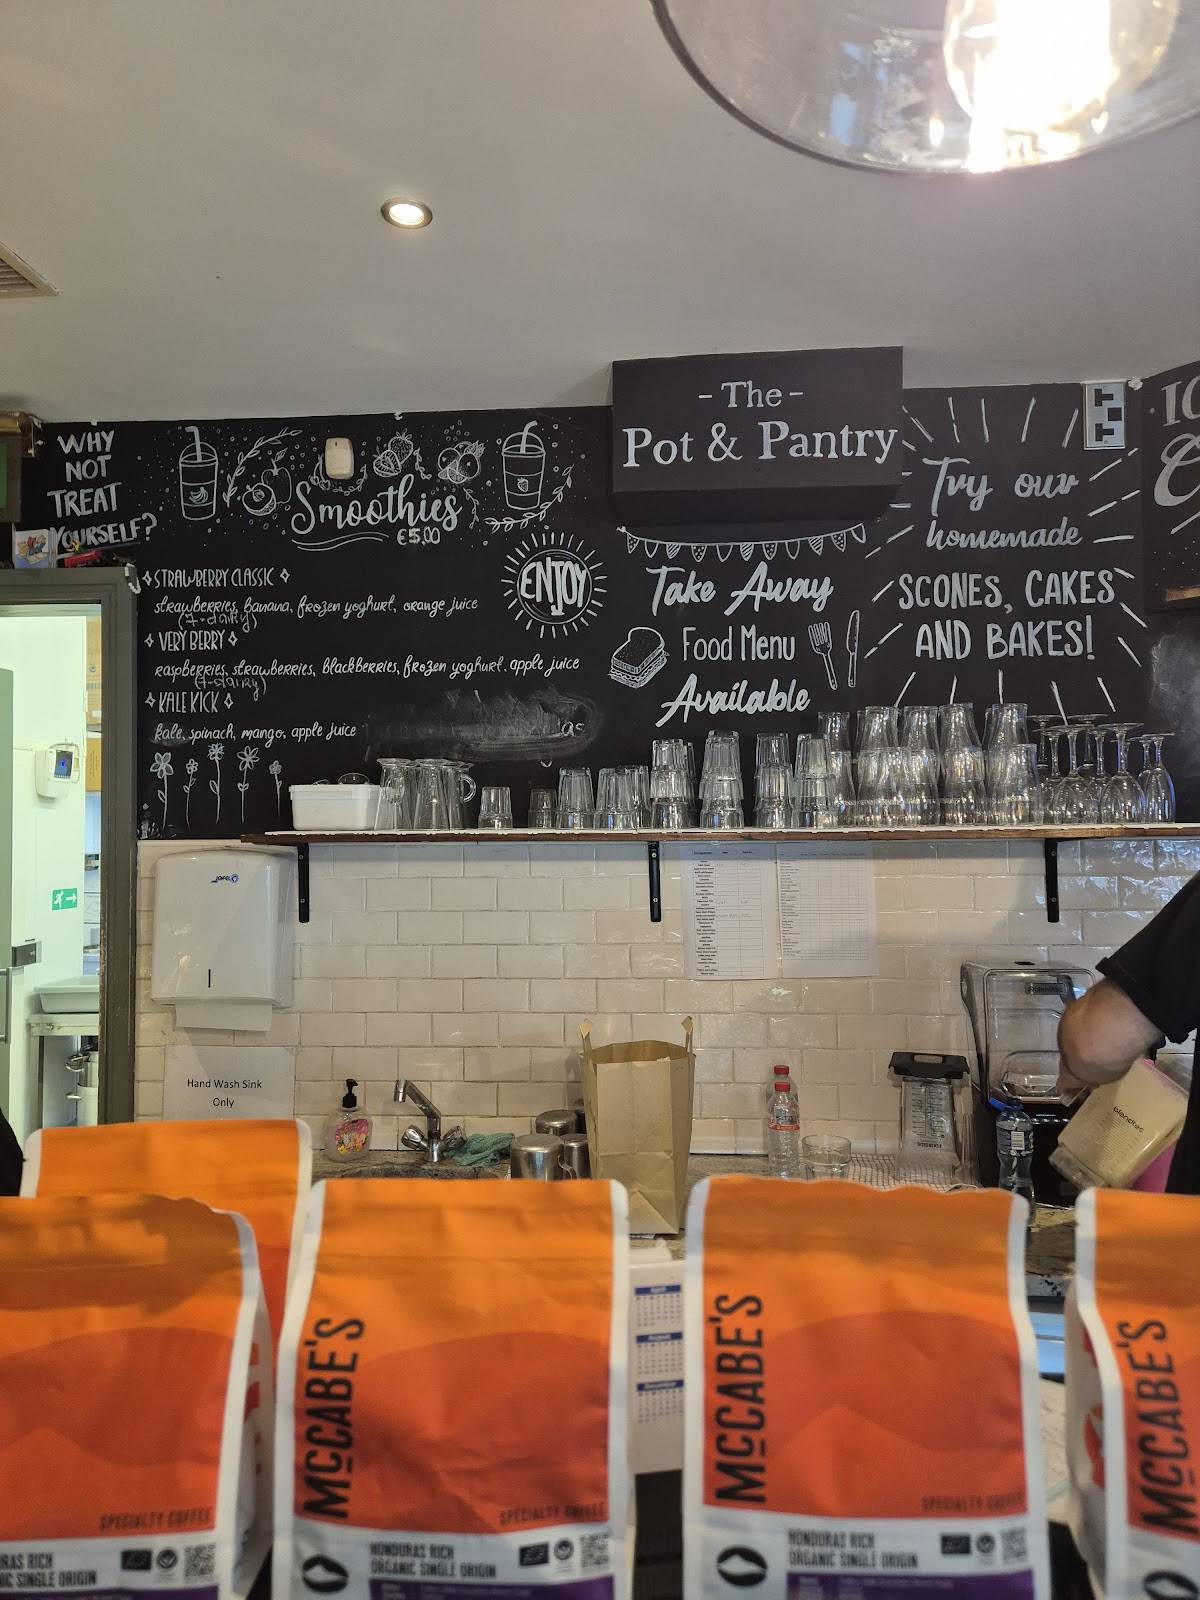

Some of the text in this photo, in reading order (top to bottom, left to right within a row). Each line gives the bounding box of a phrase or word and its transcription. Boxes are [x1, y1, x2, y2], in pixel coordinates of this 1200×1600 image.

[721, 380, 783, 408] The
[57, 430, 115, 456] WHY
[622, 420, 898, 468] Pot & Pantry
[66, 454, 112, 483] NOT
[922, 456, 1080, 517] Try our
[47, 481, 122, 519] TREAT
[291, 473, 463, 535] Smoothies
[49, 512, 158, 548] YOURSELF?
[396, 526, 441, 546] €5.00
[926, 516, 1083, 550] homemade
[154, 566, 275, 589] STRAWBERRY CLASSIC
[520, 556, 587, 616] ENJOY
[645, 560, 834, 617] Take Away
[898, 569, 1116, 616] SCONES, CAKES
[154, 595, 239, 614] strawberries,
[297, 594, 341, 619] frozen
[342, 594, 397, 619] yoghurt,
[403, 598, 446, 618] orange
[446, 596, 479, 617] juice
[158, 629, 226, 652] VERY BERRY
[682, 623, 796, 662] Food Menu
[915, 614, 1096, 662] AND BAKES!
[154, 658, 229, 684] raspberries,
[231, 658, 317, 678] strawberries,
[403, 655, 447, 679] frozen
[509, 653, 545, 677] apple
[544, 656, 580, 678] juice
[158, 690, 220, 713] KALE KICK
[655, 672, 811, 728] Available
[291, 721, 324, 743] apple
[325, 722, 357, 741] juice
[187, 1078, 263, 1090] Hand Wash Sink
[212, 1097, 235, 1110] Only
[100, 1507, 213, 1531] SPECIALTY COFFEE
[500, 1505, 560, 1526] SPECIALTY
[369, 1541, 455, 1561] HONDURAS RICH
[788, 1528, 876, 1550] HONDURAS RICH
[27, 1551, 54, 1569] RICH
[370, 1558, 497, 1579] ORGANIC SINGLE ORIGIN
[789, 1548, 919, 1569] ORGANIC SINGLE ORIGIN
[16, 1571, 55, 1589] SINGLE
[59, 1570, 97, 1587] ORIGIN
